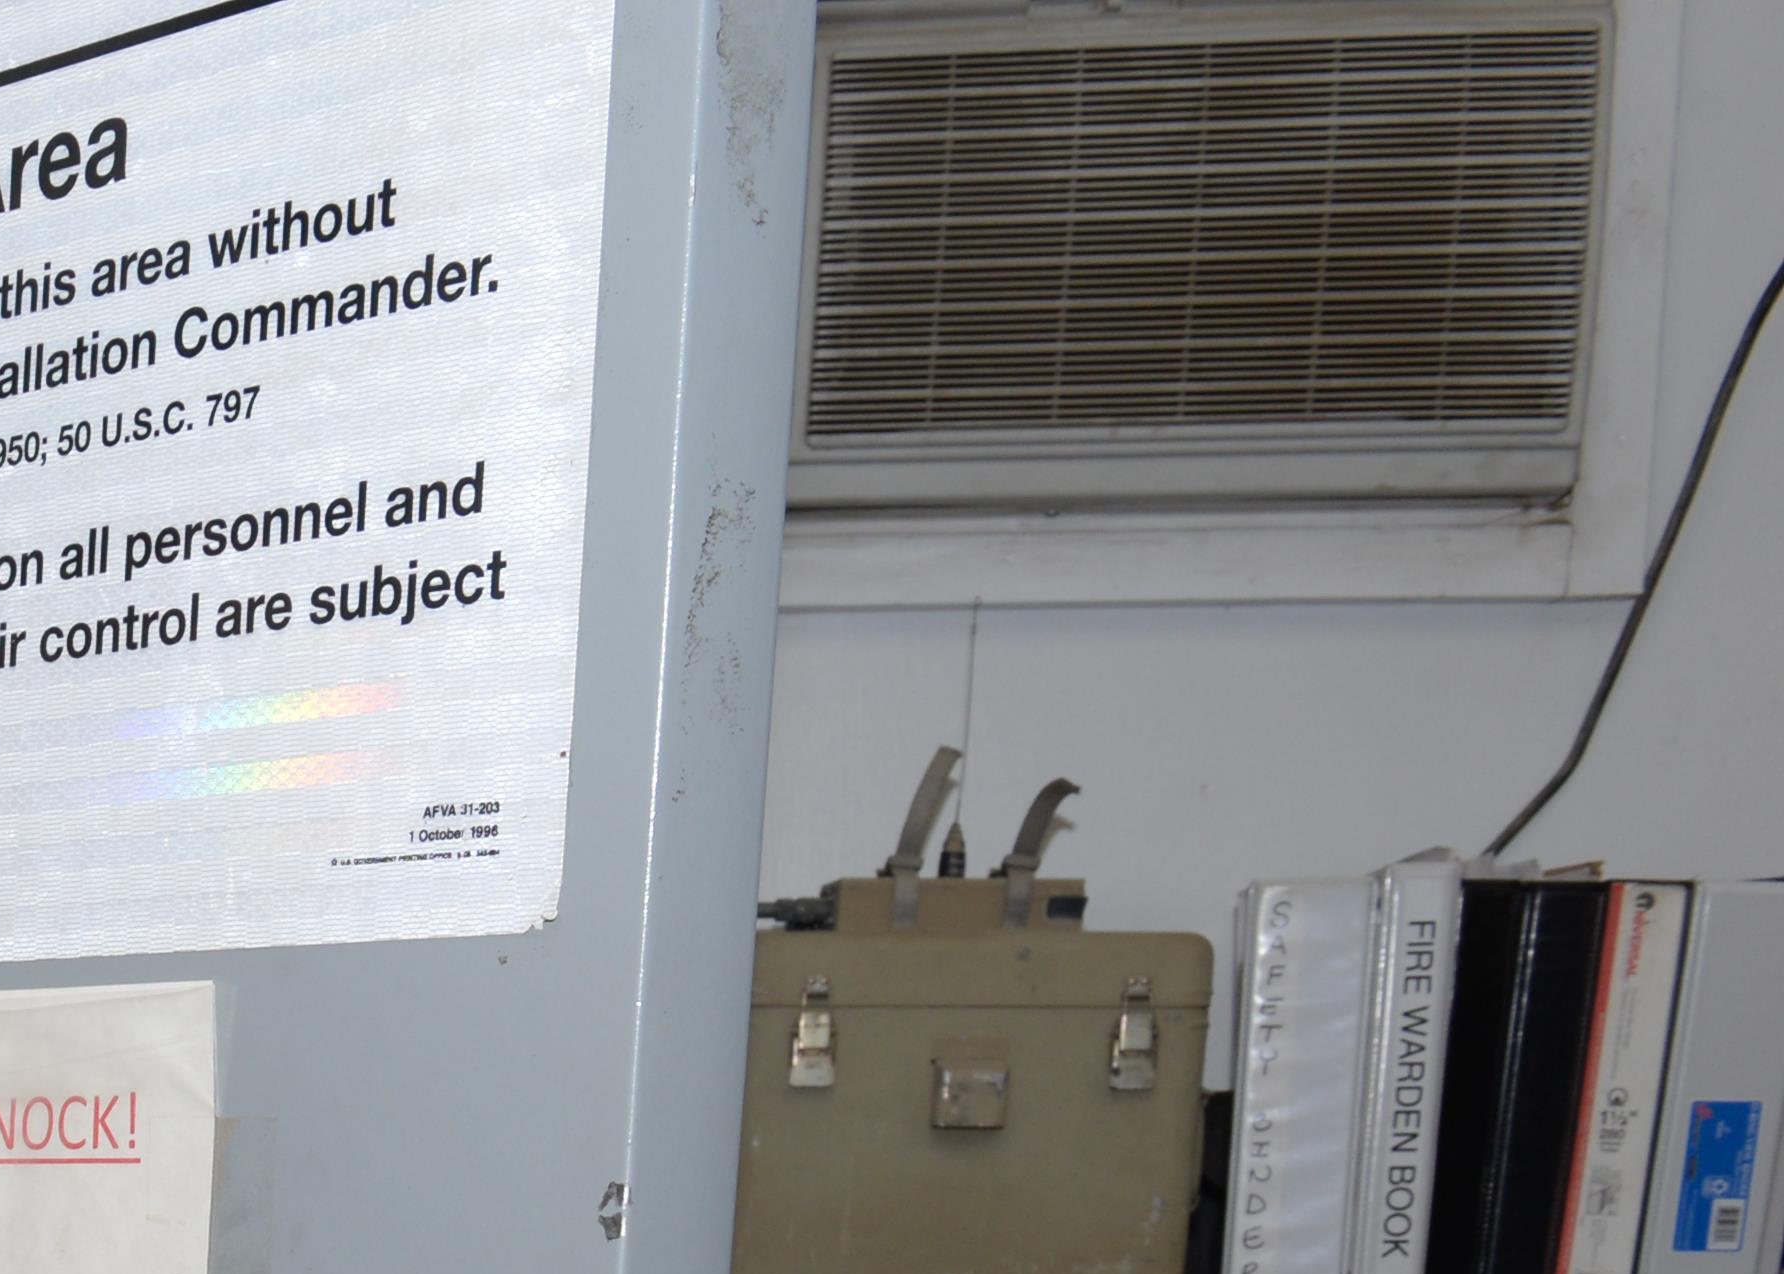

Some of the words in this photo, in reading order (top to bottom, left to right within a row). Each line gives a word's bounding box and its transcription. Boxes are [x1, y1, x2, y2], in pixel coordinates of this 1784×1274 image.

[0, 263, 75, 318] this
[92, 241, 190, 296] area
[209, 179, 396, 267] without
[175, 255, 497, 358] Commander.
[58, 420, 91, 456] 50
[103, 400, 193, 448] U.S.C.
[207, 385, 260, 426] 797
[60, 526, 108, 579] all
[125, 481, 366, 581] personnel
[386, 462, 484, 526] and
[40, 593, 199, 662] control
[216, 593, 291, 637] are
[310, 551, 506, 624] subject
[423, 804, 456, 819] AFVA
[460, 801, 500, 815] 31-203
[470, 825, 498, 839] 1996
[1258, 901, 1294, 1076] SAFETY
[1403, 921, 1436, 995] FIRE
[1390, 1006, 1429, 1153] WARDEN
[1382, 1166, 1418, 1258] BOOK
